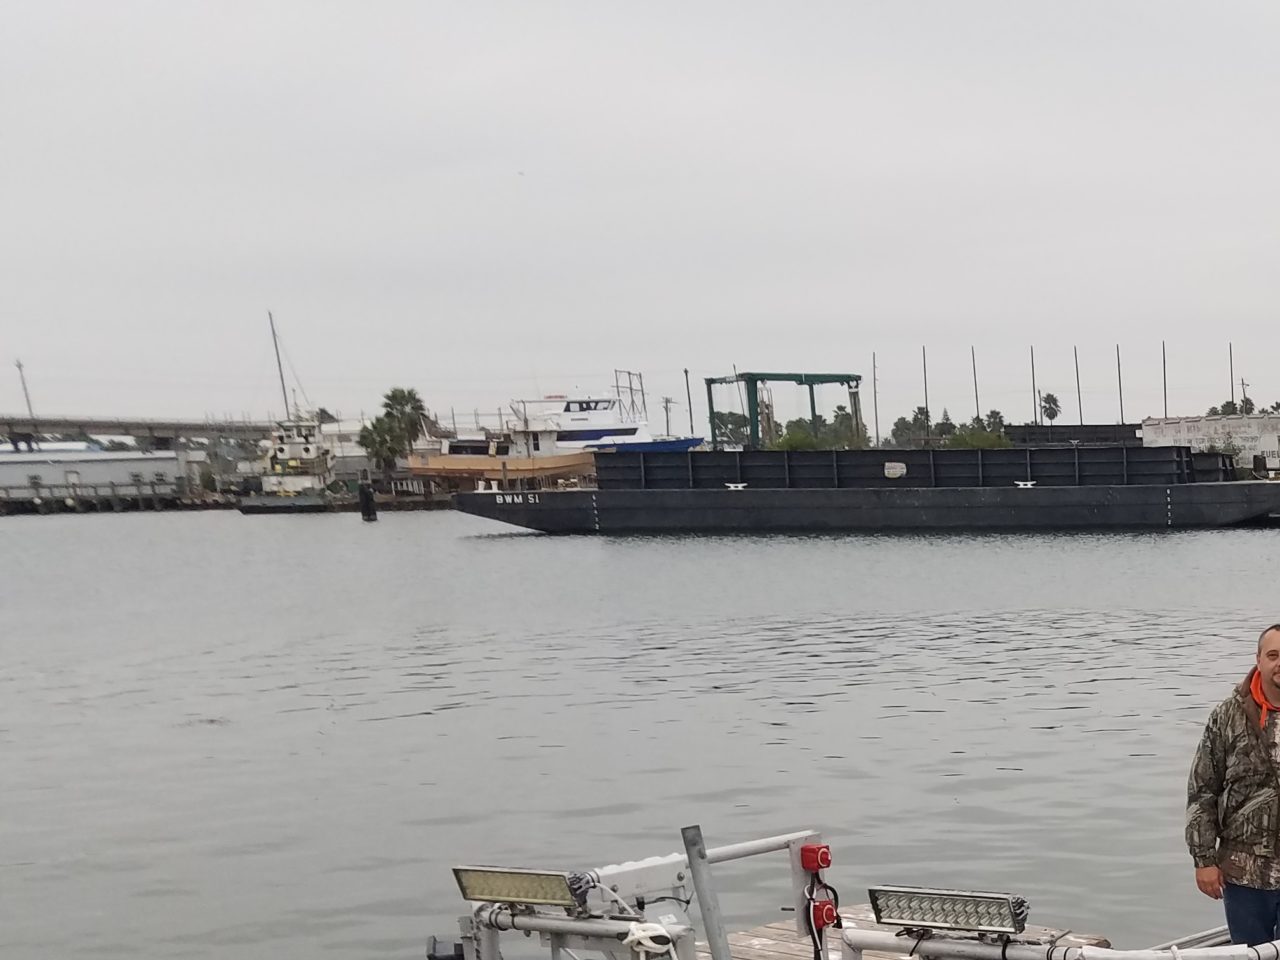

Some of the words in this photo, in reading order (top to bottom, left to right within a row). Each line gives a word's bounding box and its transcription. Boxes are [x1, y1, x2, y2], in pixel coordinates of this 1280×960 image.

[1261, 450, 1280, 458] FUEL
[495, 494, 523, 504] BWM
[528, 494, 540, 504] 51
